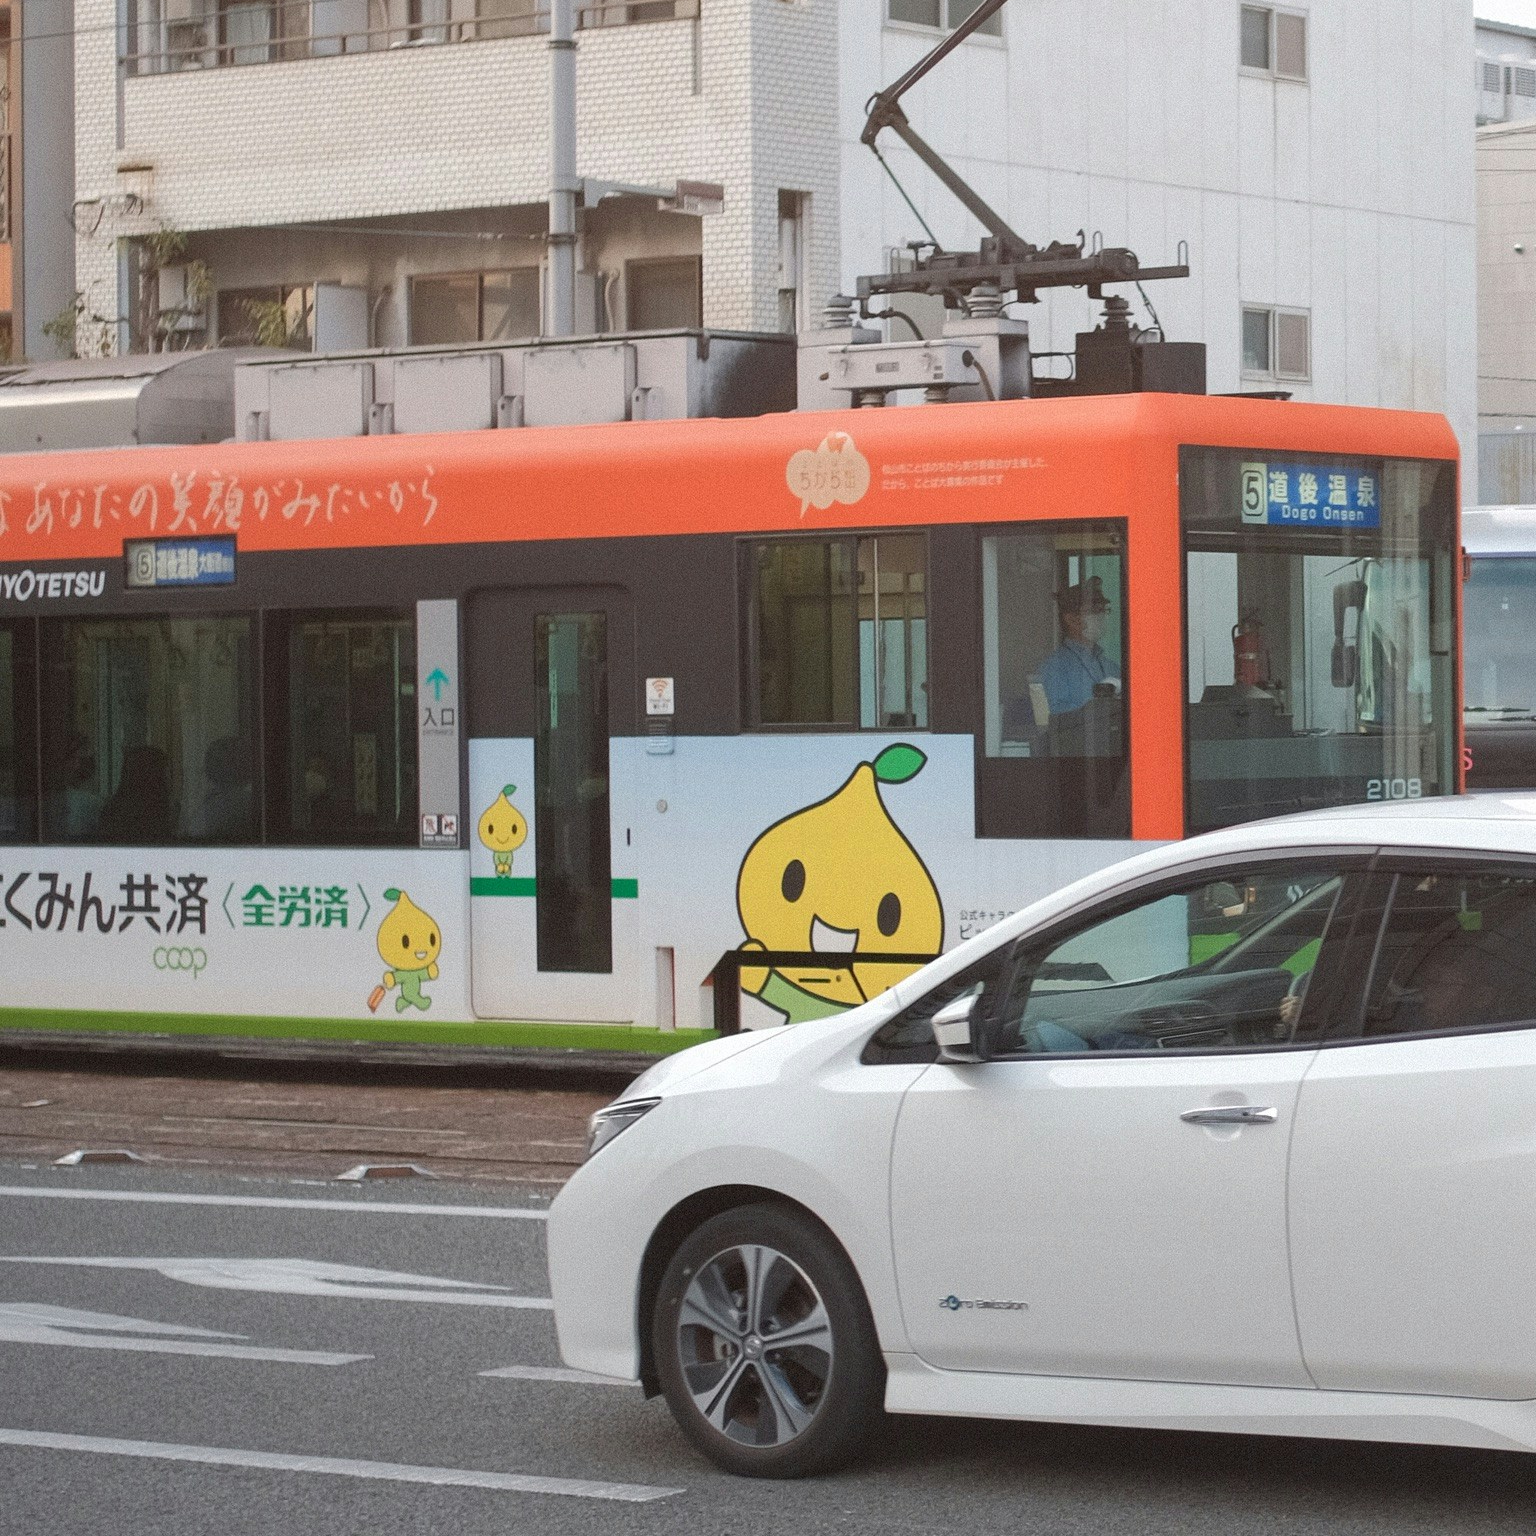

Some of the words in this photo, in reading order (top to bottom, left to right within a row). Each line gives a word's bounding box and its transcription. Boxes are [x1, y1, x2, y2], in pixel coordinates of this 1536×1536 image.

[1245, 476, 1260, 510] 5
[1269, 471, 1375, 507] 道後温泉
[1282, 505, 1317, 521] Dogo
[1323, 506, 1365, 522] Onsen
[139, 554, 150, 575] 5
[423, 707, 455, 727] 入口
[1367, 778, 1422, 799] 2108
